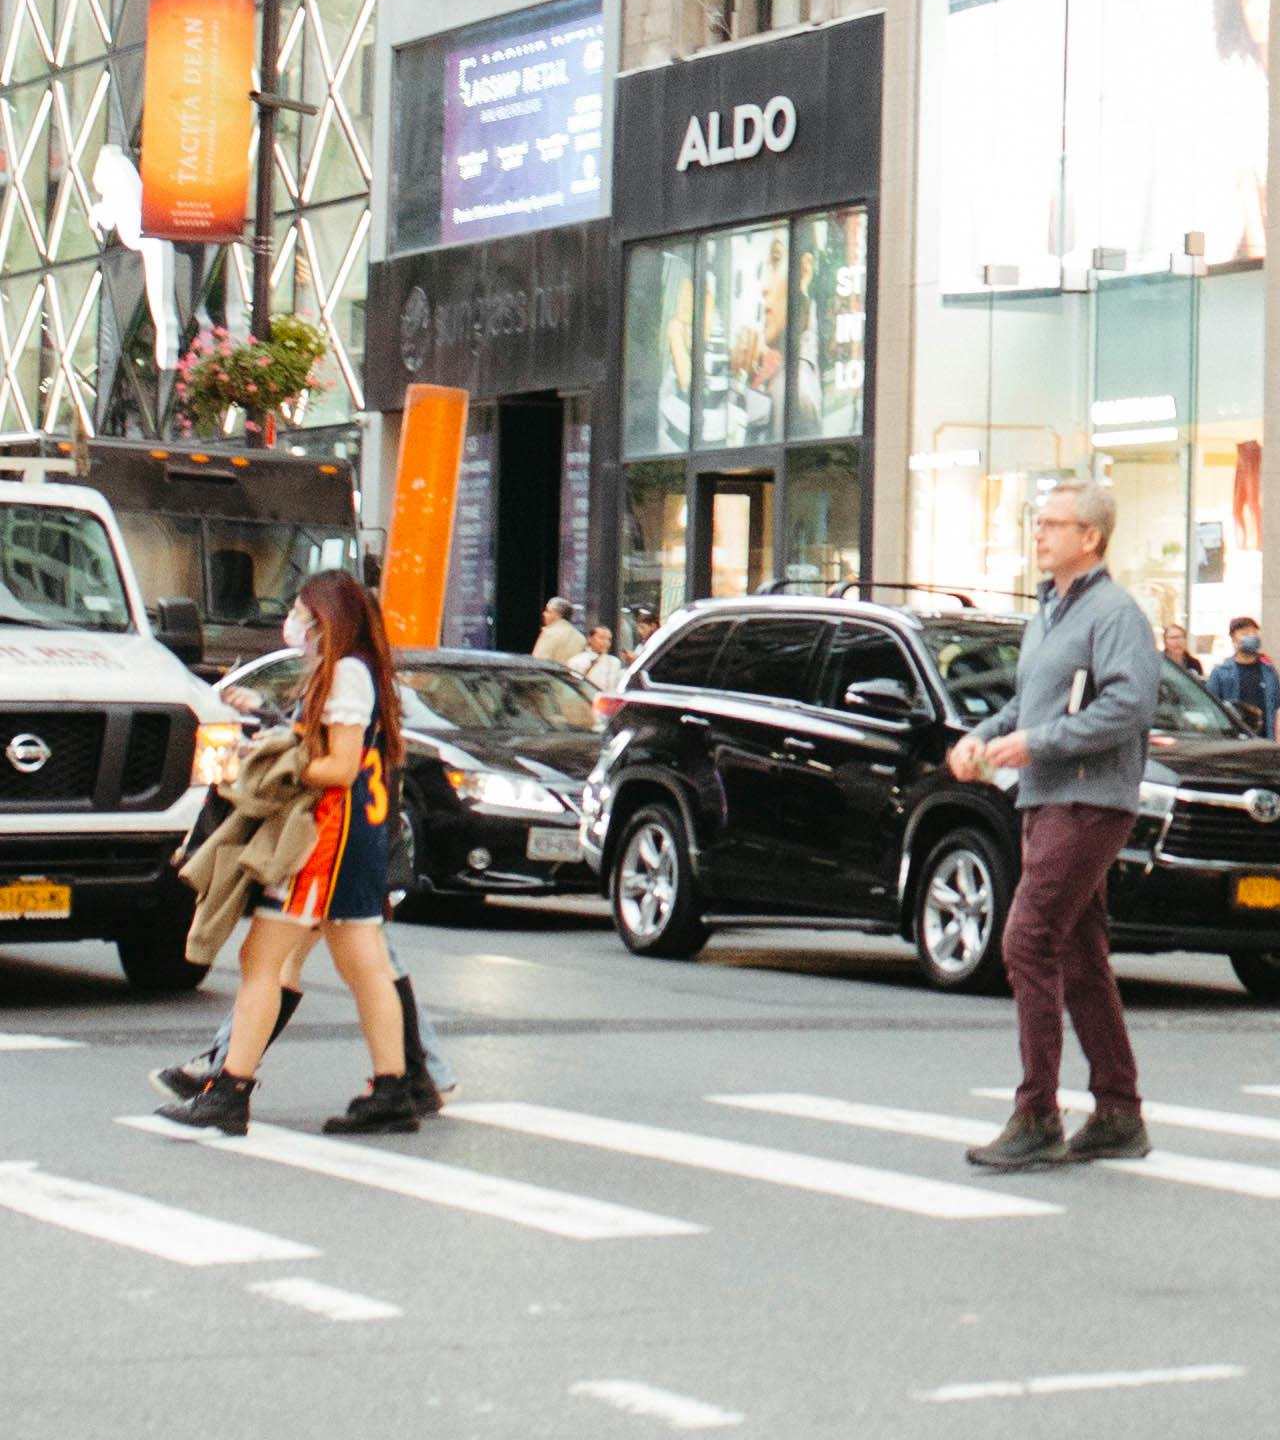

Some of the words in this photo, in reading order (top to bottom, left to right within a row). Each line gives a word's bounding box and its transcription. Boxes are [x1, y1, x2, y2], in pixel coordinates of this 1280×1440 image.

[183, 17, 204, 85] DEAN
[176, 92, 202, 186] TACITA
[676, 95, 797, 172] ALDO
